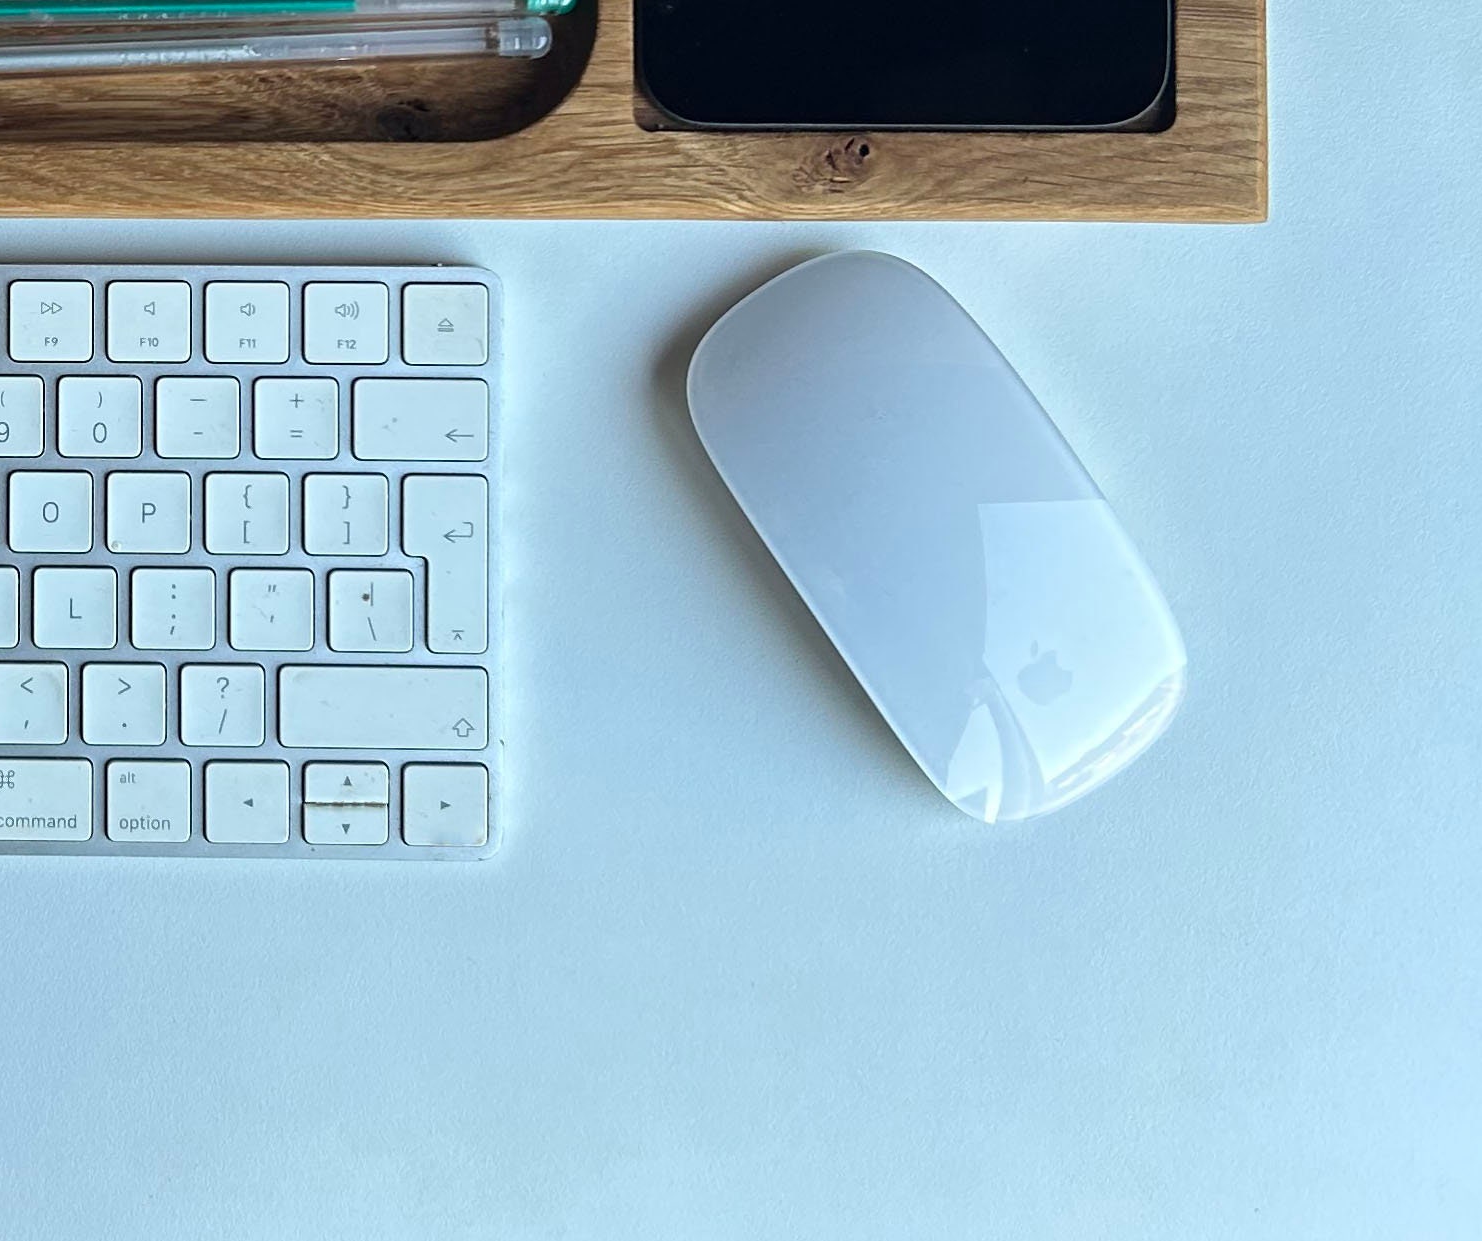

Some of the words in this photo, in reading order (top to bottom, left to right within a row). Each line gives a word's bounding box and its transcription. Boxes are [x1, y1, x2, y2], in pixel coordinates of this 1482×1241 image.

[44, 336, 59, 347] F9
[139, 337, 160, 348] F10
[239, 337, 257, 349] F11
[337, 339, 357, 350] F12
[289, 393, 305, 409] +
[92, 421, 108, 444] 0
[242, 484, 252, 510] {
[341, 484, 352, 510] }
[42, 501, 60, 524] O
[141, 502, 157, 524] P
[243, 520, 251, 545] [
[342, 520, 351, 545] ]
[69, 597, 83, 620] L
[20, 677, 34, 694] <
[117, 677, 132, 695] >
[216, 676, 230, 699] ?
[119, 771, 136, 784] alt
[119, 815, 171, 833] option
